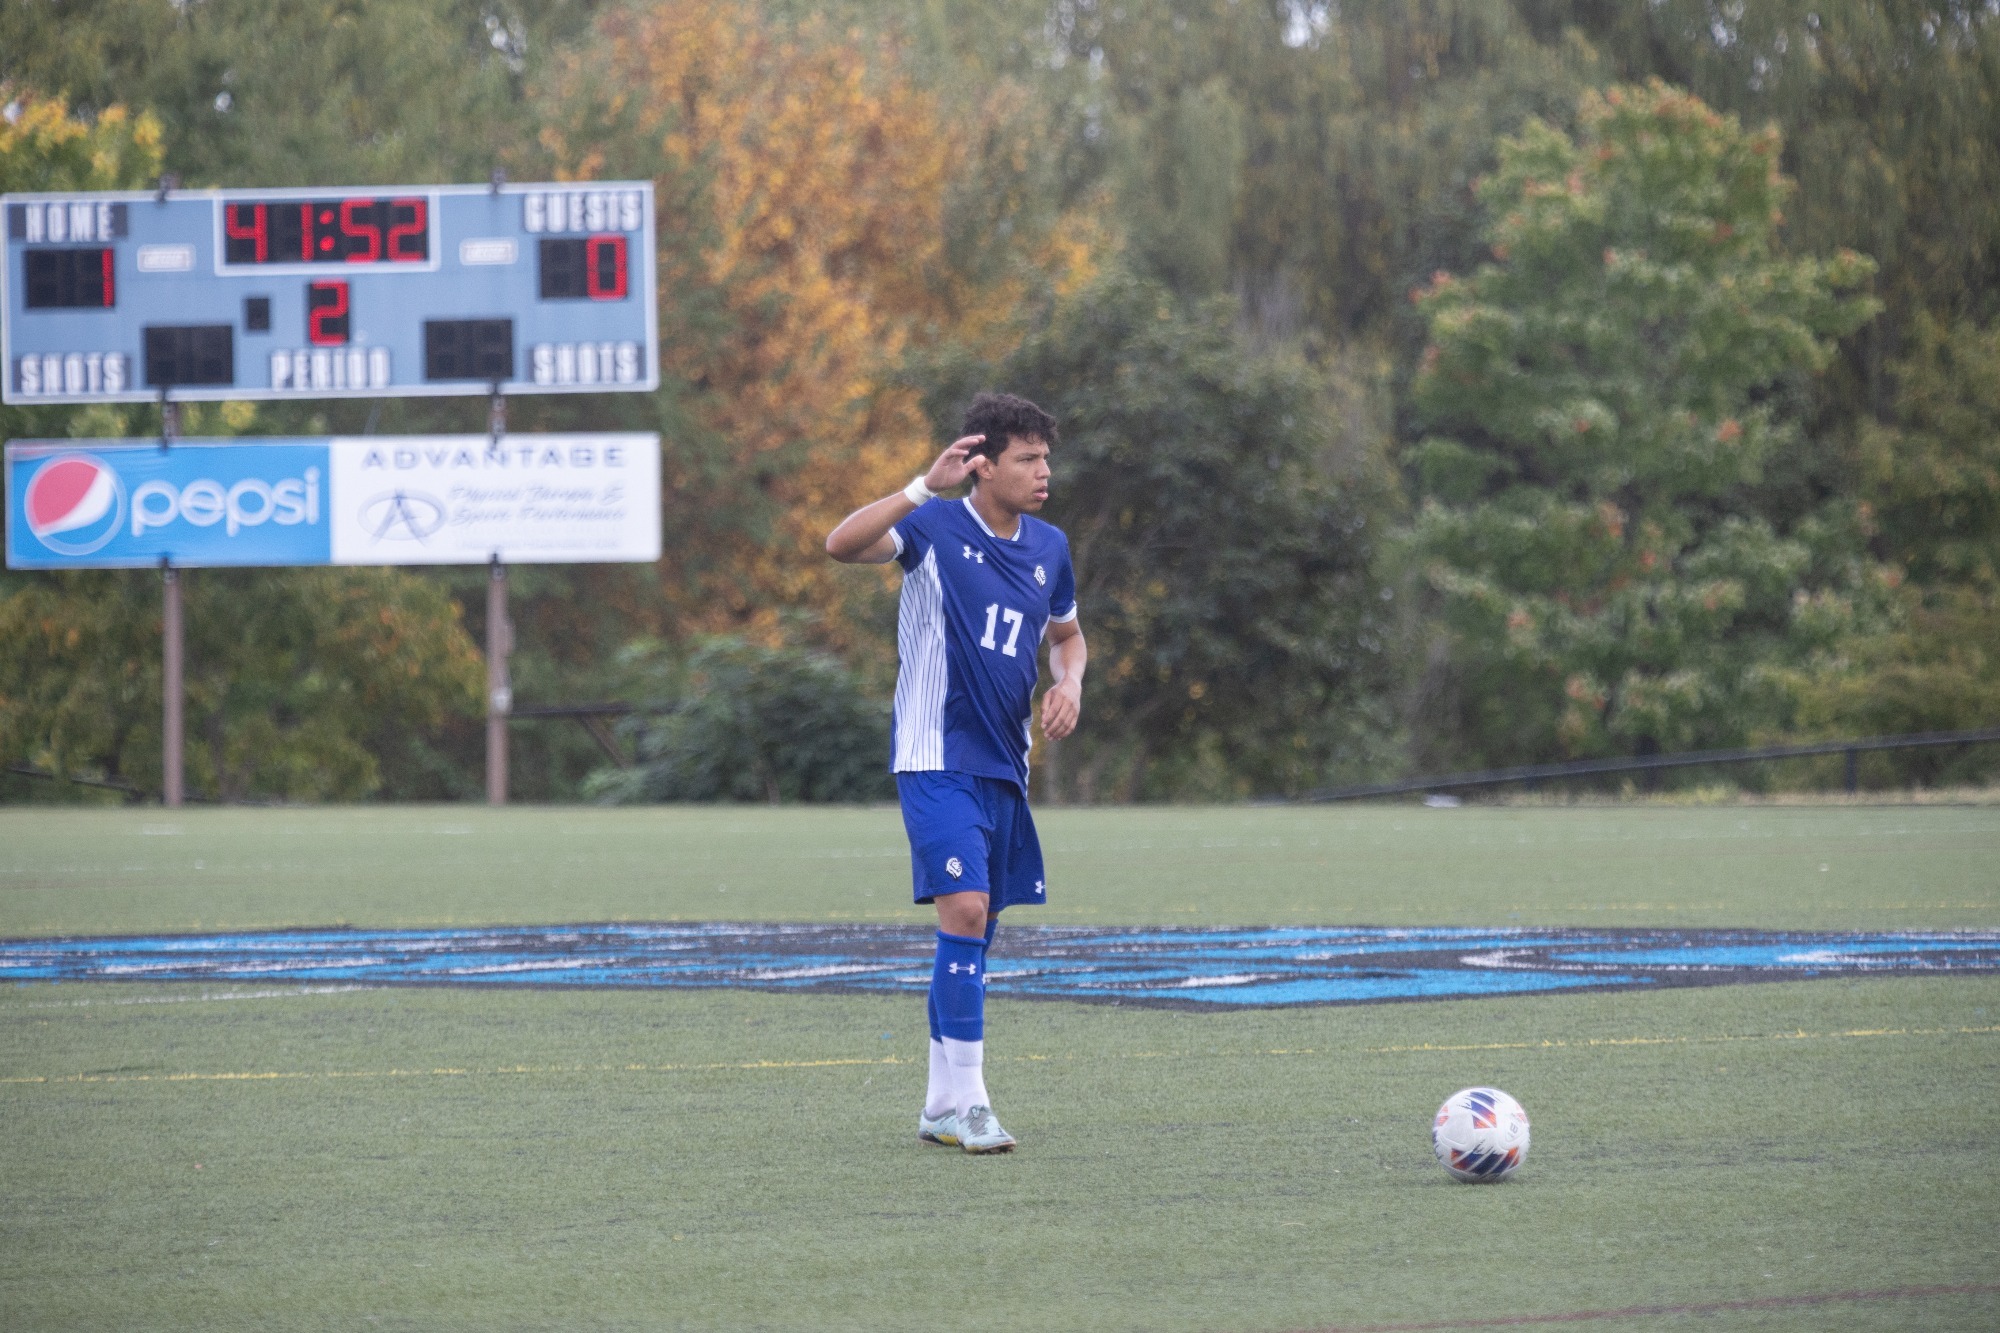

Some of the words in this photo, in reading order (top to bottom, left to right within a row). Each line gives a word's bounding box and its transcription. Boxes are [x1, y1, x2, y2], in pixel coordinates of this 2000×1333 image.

[226, 196, 428, 264] 41:52
[101, 247, 114, 308] 1
[586, 234, 628, 300] 0
[309, 278, 349, 346] 2
[362, 446, 626, 470] ADVANTAGE
[131, 466, 320, 537] pepsi
[980, 603, 1024, 658] 17
